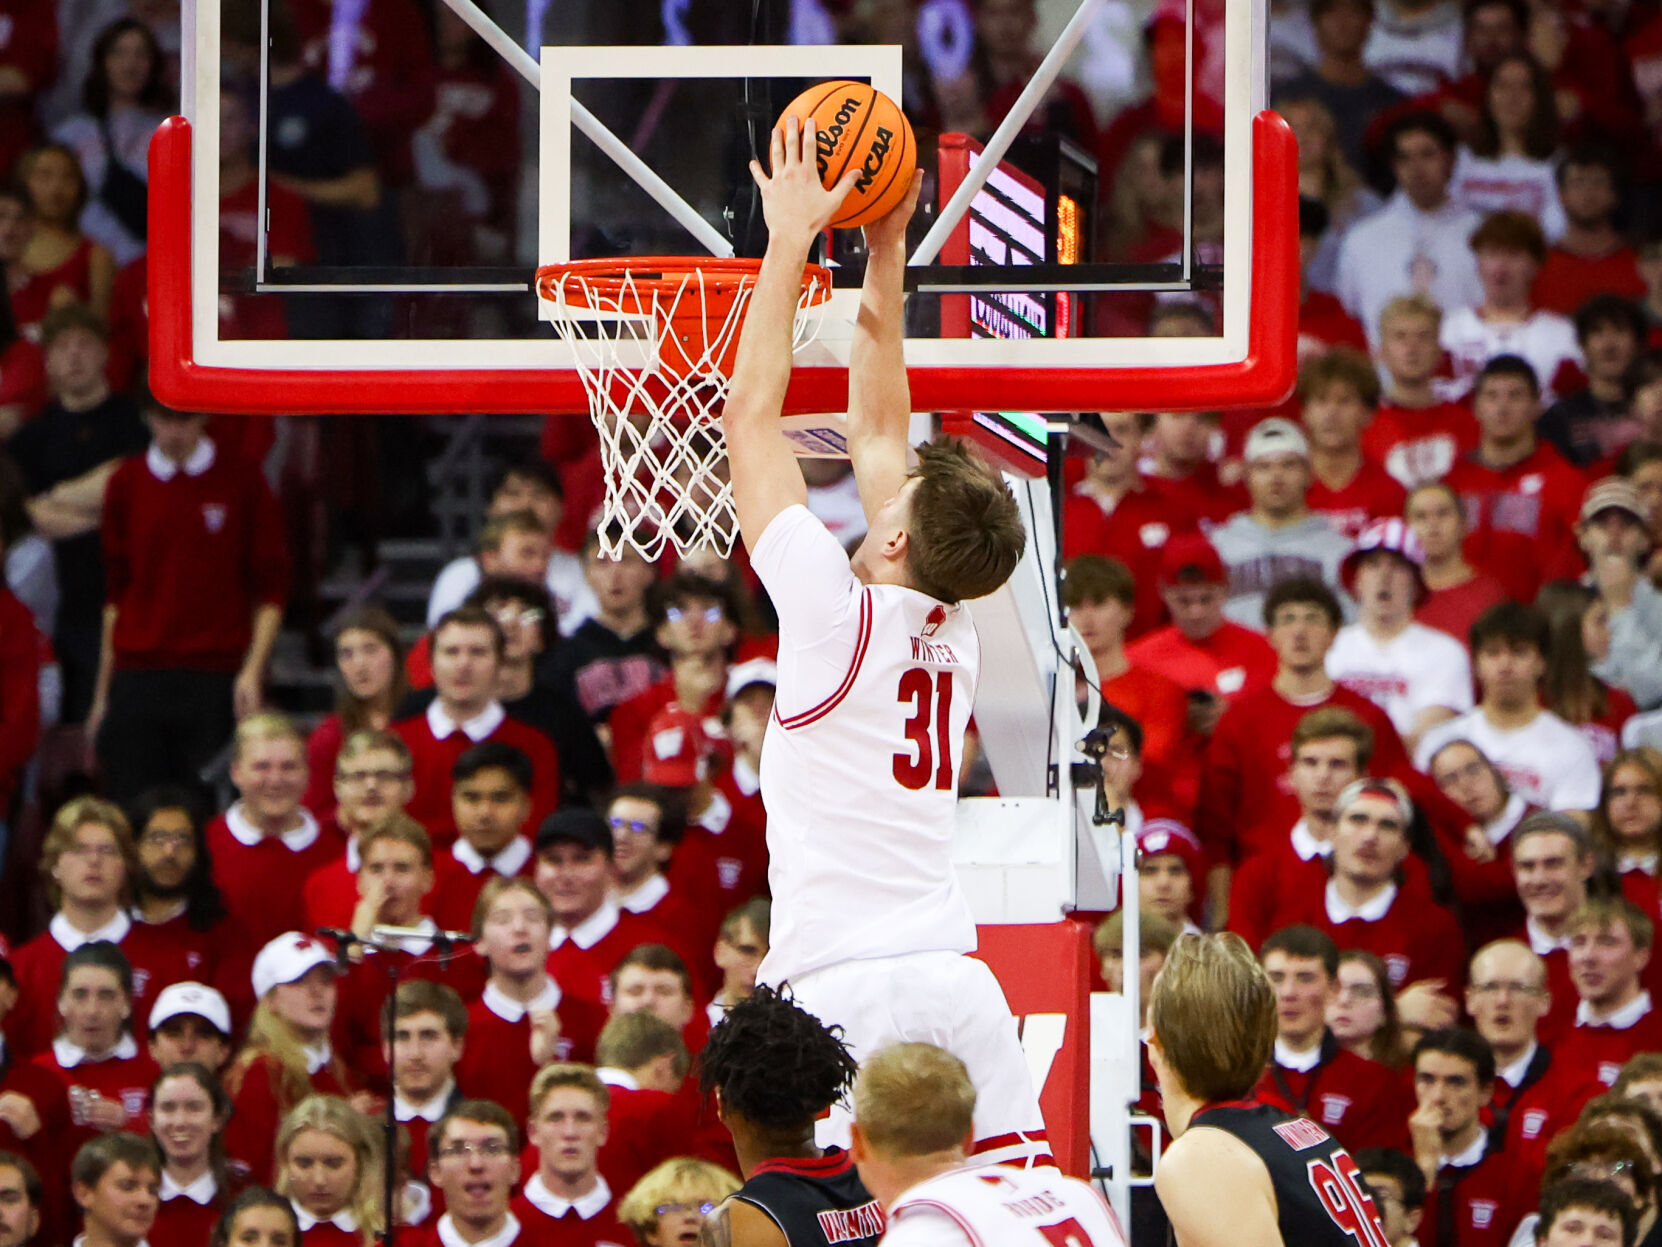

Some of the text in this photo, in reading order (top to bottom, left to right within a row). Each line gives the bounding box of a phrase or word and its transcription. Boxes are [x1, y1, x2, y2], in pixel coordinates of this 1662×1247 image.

[855, 126, 893, 194] NCAA
[910, 636, 959, 663] WINTER
[892, 667, 953, 790] 31
